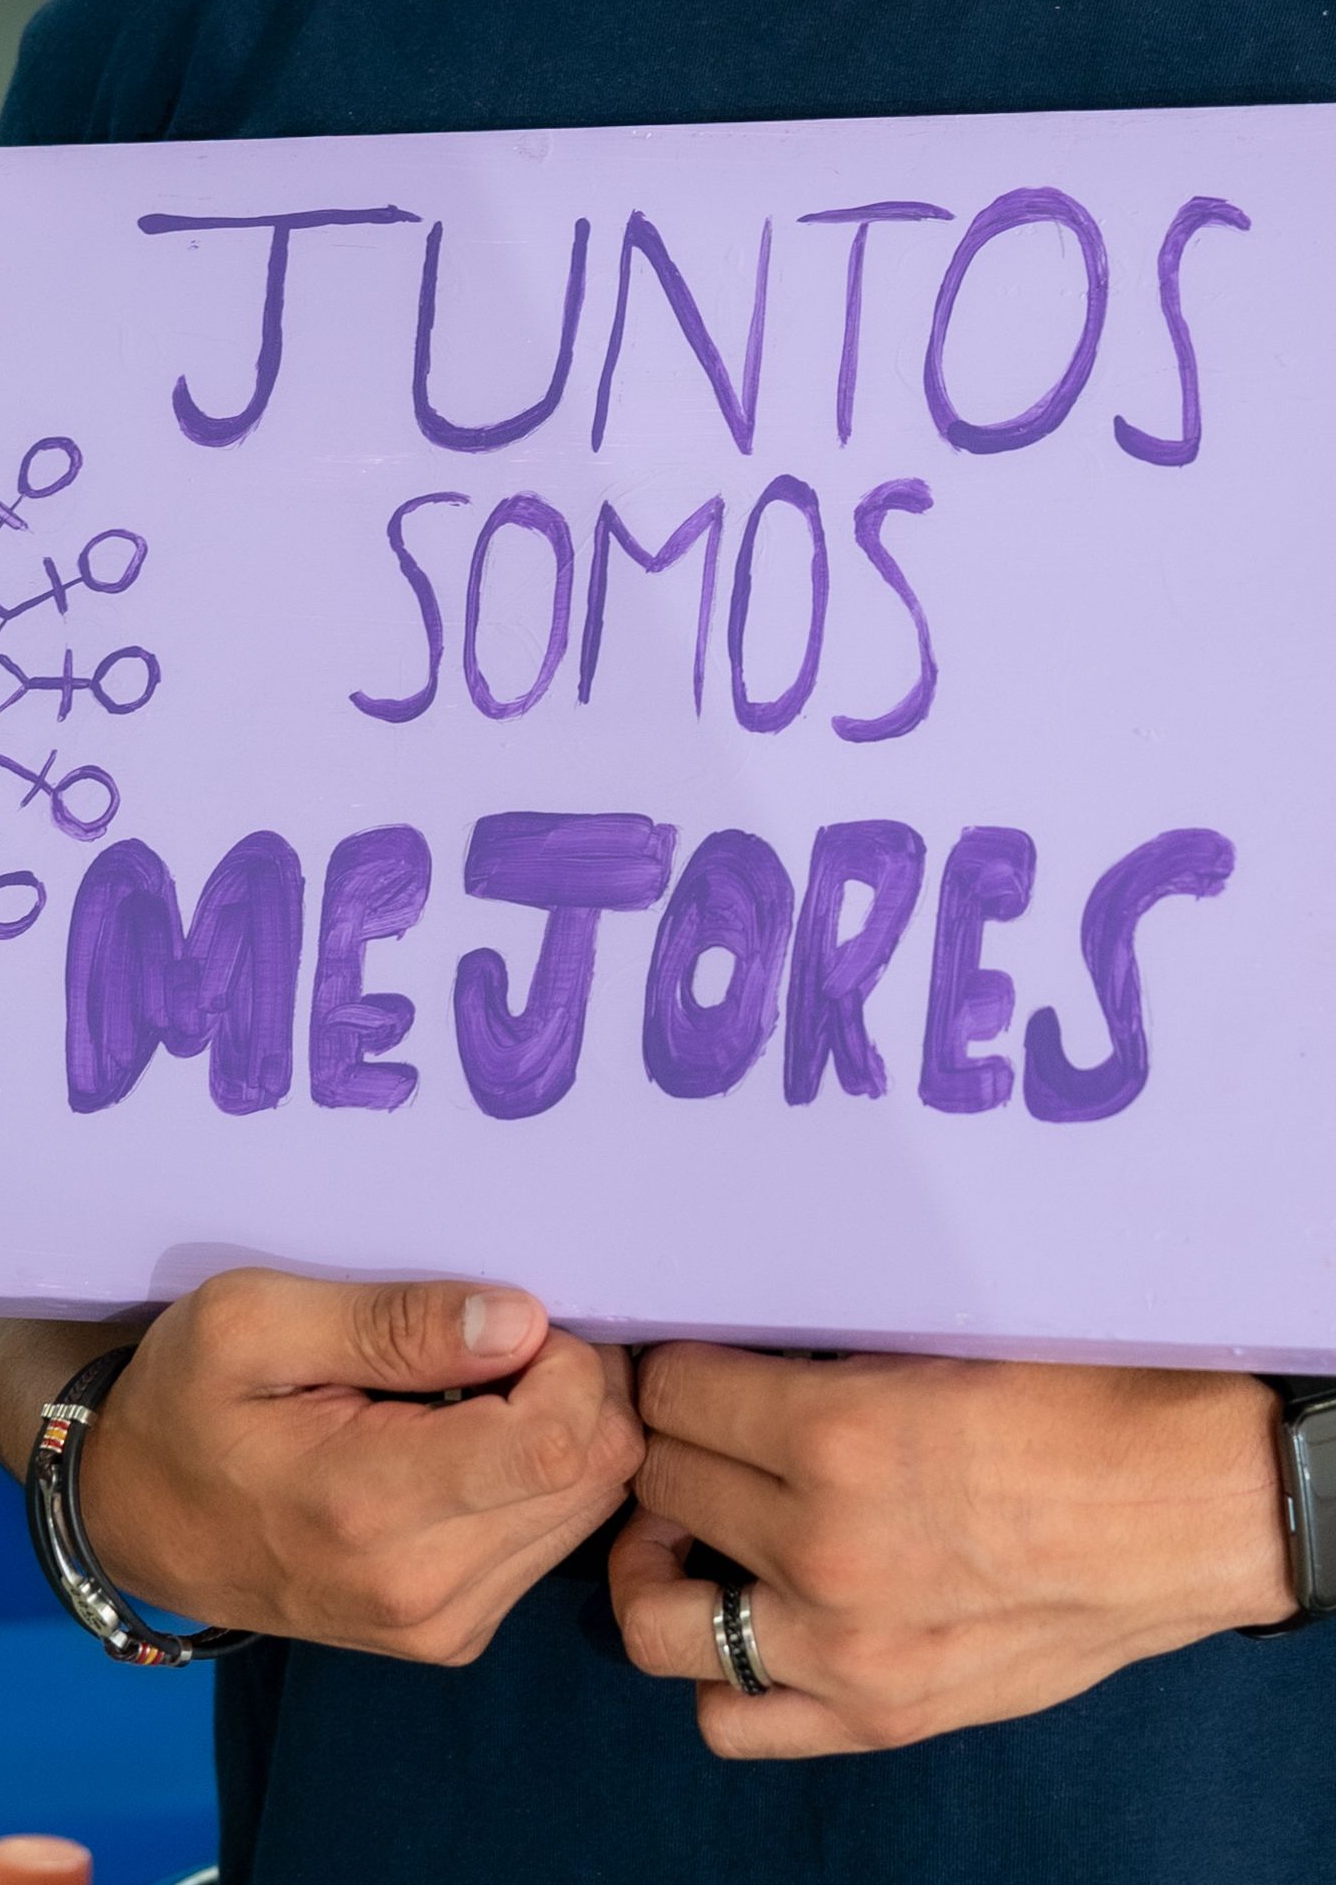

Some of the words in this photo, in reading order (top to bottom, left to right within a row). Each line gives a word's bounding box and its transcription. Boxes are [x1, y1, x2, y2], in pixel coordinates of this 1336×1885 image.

[137, 186, 1252, 468] JUNTOS
[348, 473, 939, 744] SOMOS
[64, 810, 1236, 1124] MEJORES
